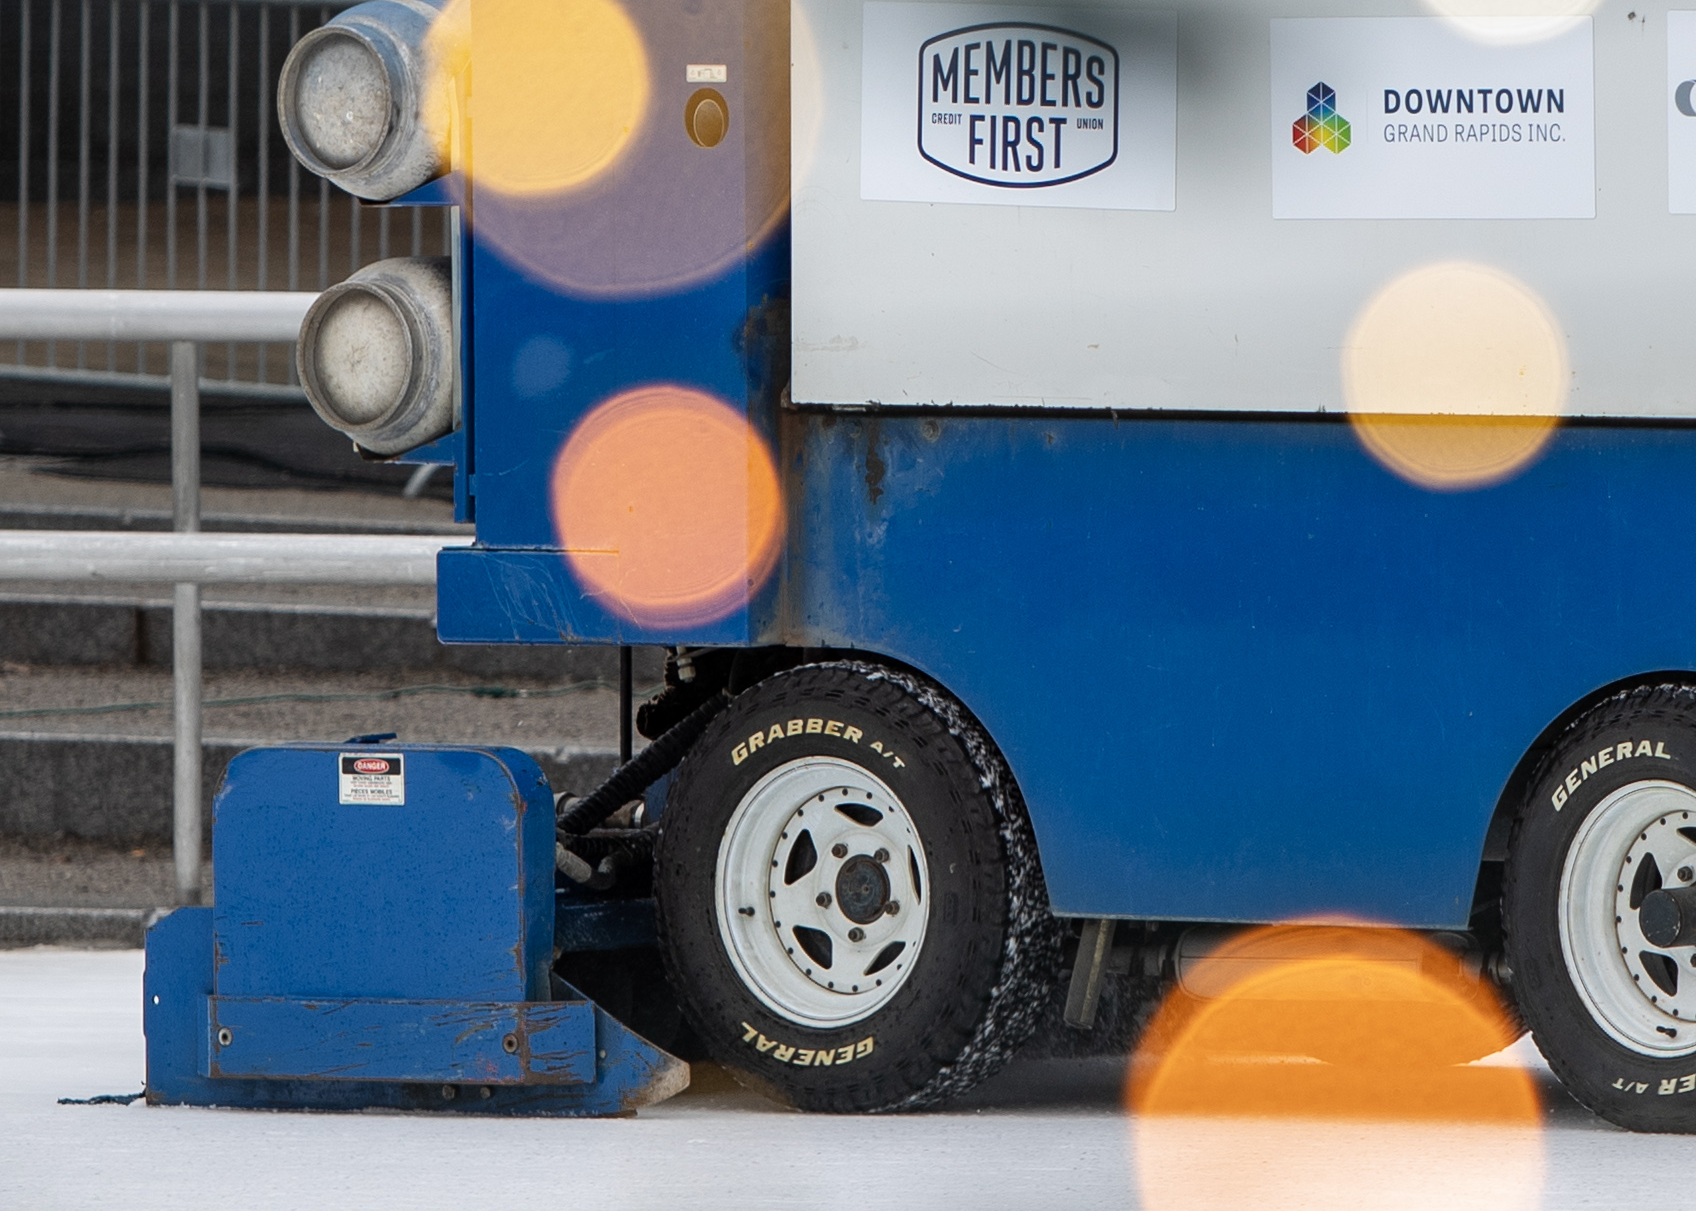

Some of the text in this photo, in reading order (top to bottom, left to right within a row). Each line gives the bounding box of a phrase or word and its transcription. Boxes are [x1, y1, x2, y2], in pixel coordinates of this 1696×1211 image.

[932, 39, 1105, 109] MEMBERS
[1384, 88, 1565, 114] DOWNTOWN
[931, 112, 963, 126] CREDIT
[1076, 117, 1104, 130] UNION
[968, 114, 1068, 173] FIRST
[1384, 123, 1566, 143] GRAND RAPIDS INC.
[731, 718, 906, 770] GRABBER A/T
[357, 761, 386, 770] DANGER
[1550, 740, 1672, 812] GENERAL
[741, 1021, 875, 1067] GENERAL
[1612, 1078, 1645, 1094] A/T
